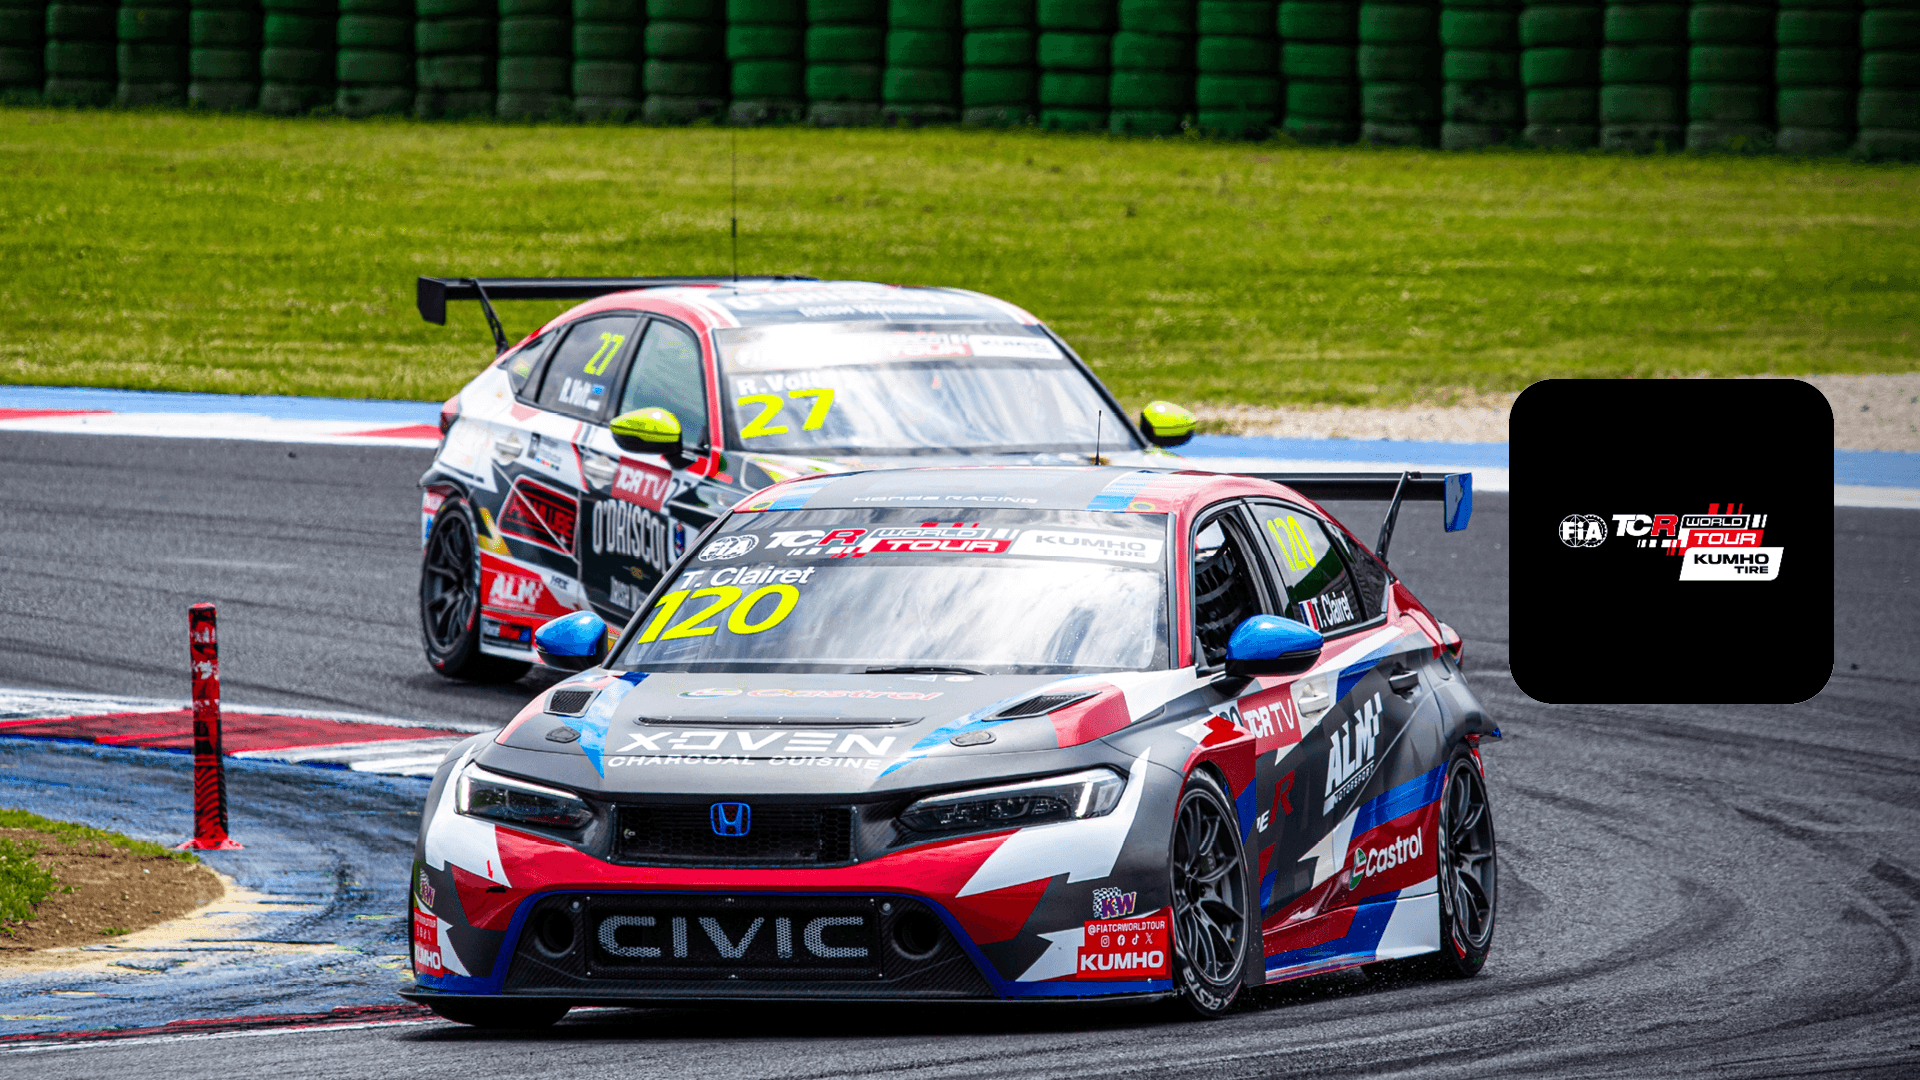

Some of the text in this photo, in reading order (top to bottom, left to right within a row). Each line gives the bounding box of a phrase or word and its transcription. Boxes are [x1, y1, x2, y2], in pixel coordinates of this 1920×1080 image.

[583, 332, 626, 376] 27
[737, 388, 834, 439] 27
[765, 528, 868, 549] TCR
[877, 529, 977, 538] WORLD
[1036, 534, 1147, 551] KUMHO
[1266, 515, 1317, 572] 120
[886, 540, 1000, 551] TOUR
[1098, 549, 1146, 558] TIRE
[680, 565, 816, 590] T. Clairet
[638, 583, 800, 644] 120
[748, 687, 944, 701] Castrol
[1325, 691, 1383, 798] ALM
[608, 754, 884, 770] CHARCOAL CUISINE
[1366, 825, 1423, 877] Castrol
[598, 915, 868, 958] CIVIC
[1080, 950, 1164, 971] KUMHO
